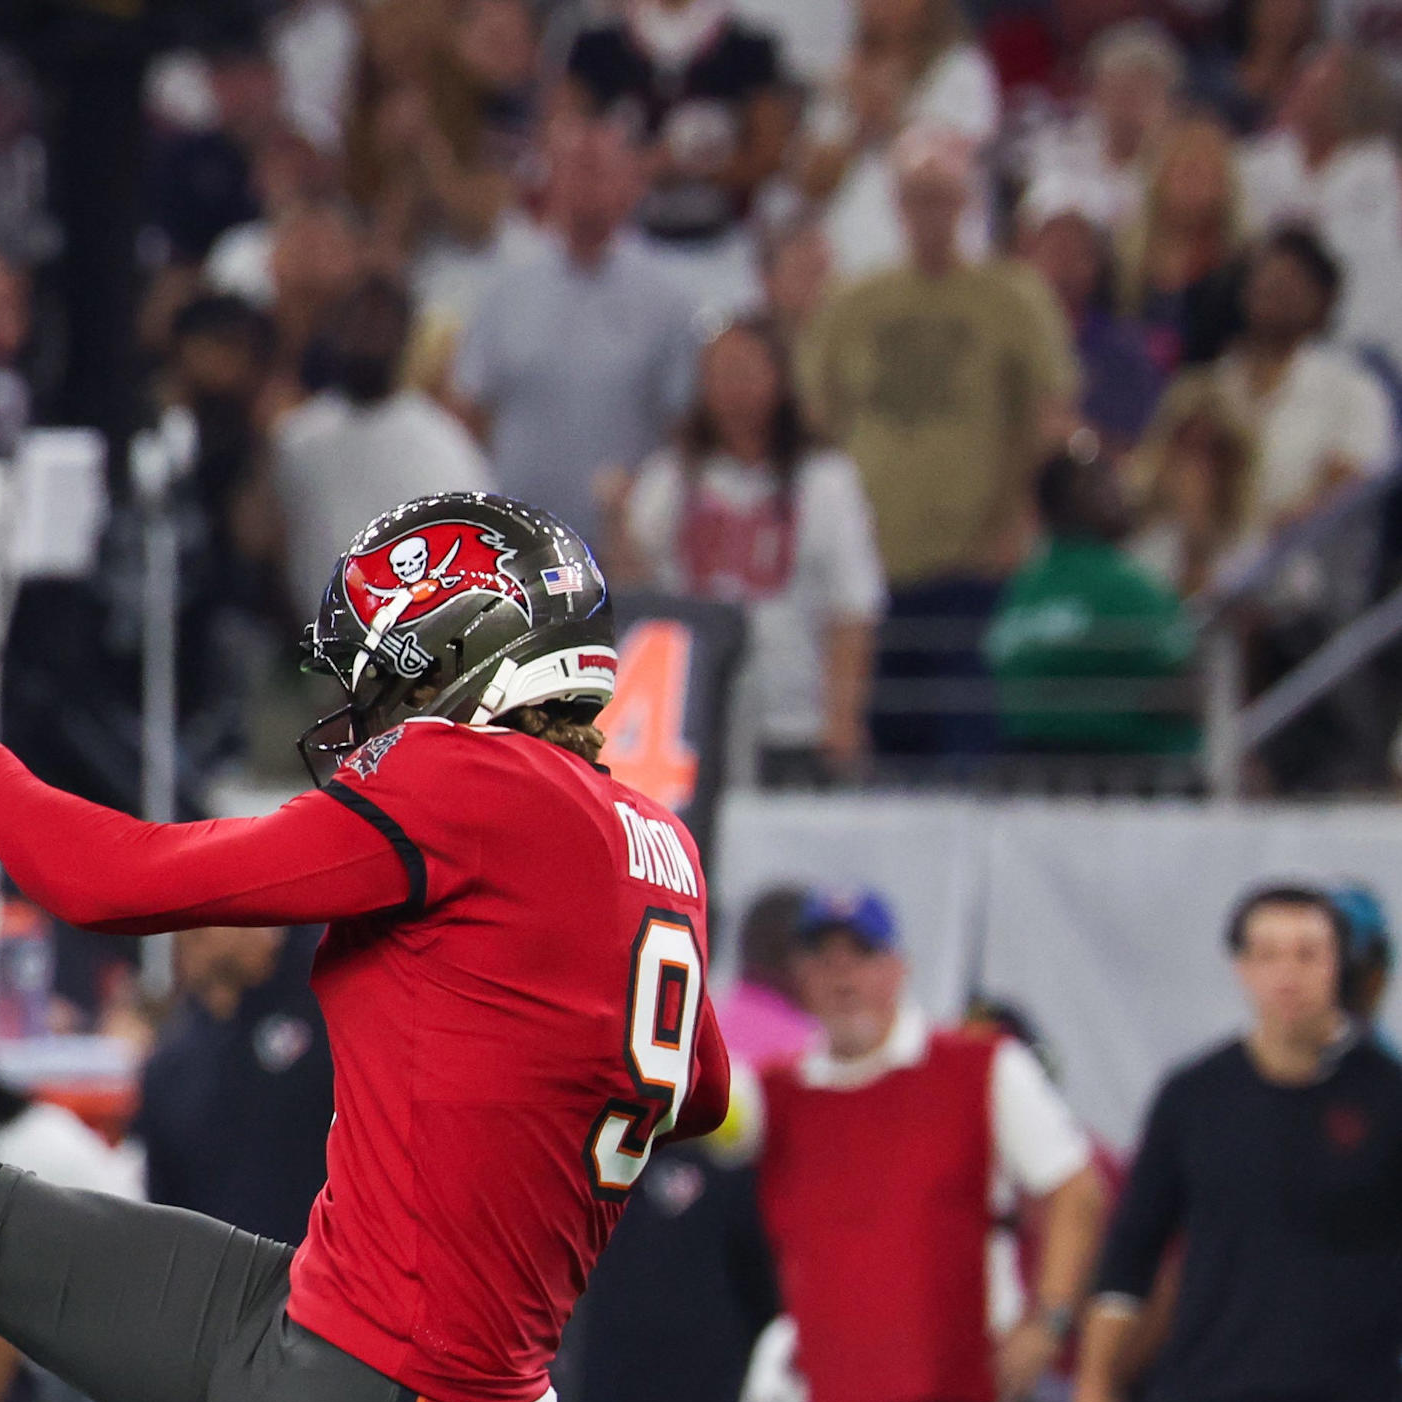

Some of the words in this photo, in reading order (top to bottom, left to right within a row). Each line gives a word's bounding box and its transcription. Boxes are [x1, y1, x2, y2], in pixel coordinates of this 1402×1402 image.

[592, 620, 698, 813] 4
[613, 801, 698, 898] DIXON
[582, 906, 703, 1202] 9
